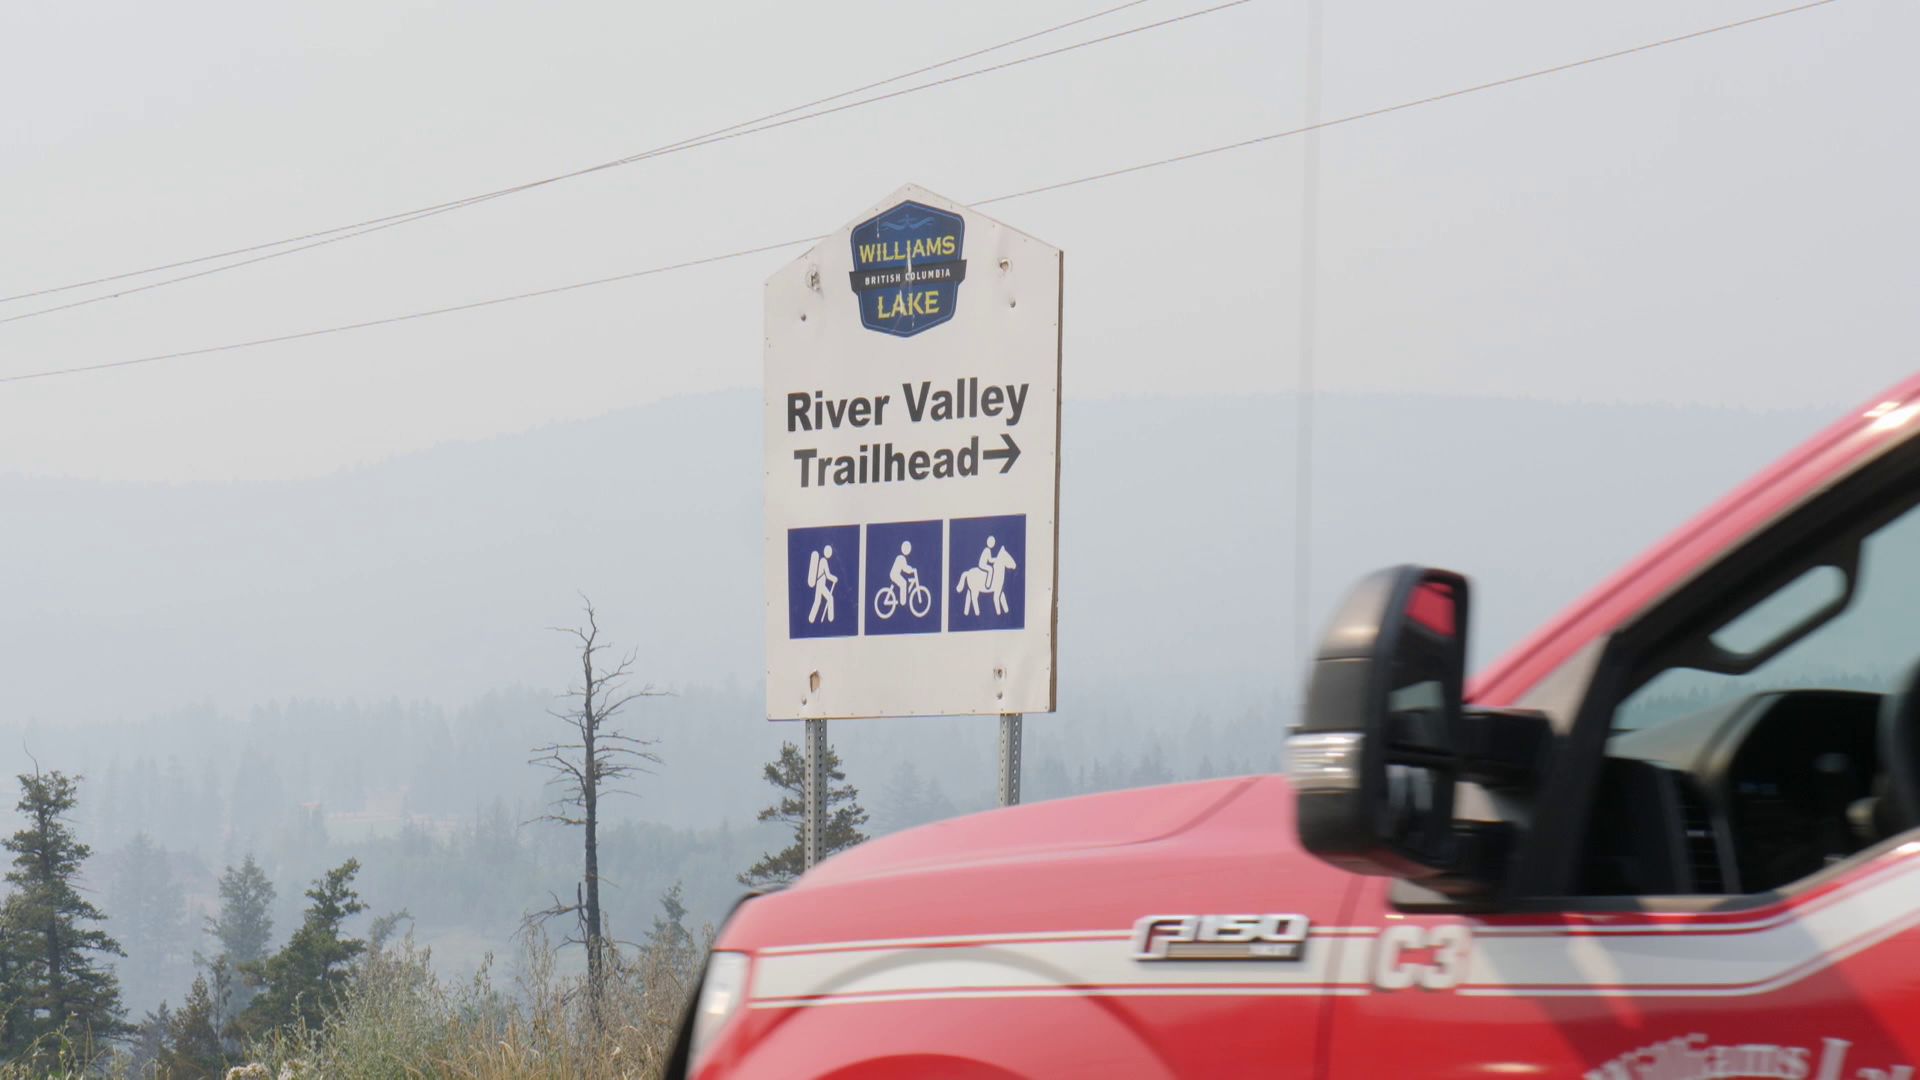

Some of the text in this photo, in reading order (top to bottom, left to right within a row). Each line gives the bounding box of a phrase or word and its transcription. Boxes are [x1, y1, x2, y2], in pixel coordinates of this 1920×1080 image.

[859, 235, 956, 264] WILLIAMS
[865, 268, 951, 285] BRITISH COLUMBIA
[877, 290, 940, 319] LAKE
[787, 377, 1029, 432] River Valley
[794, 435, 979, 488] Trailhead
[1374, 924, 1473, 990] C3
